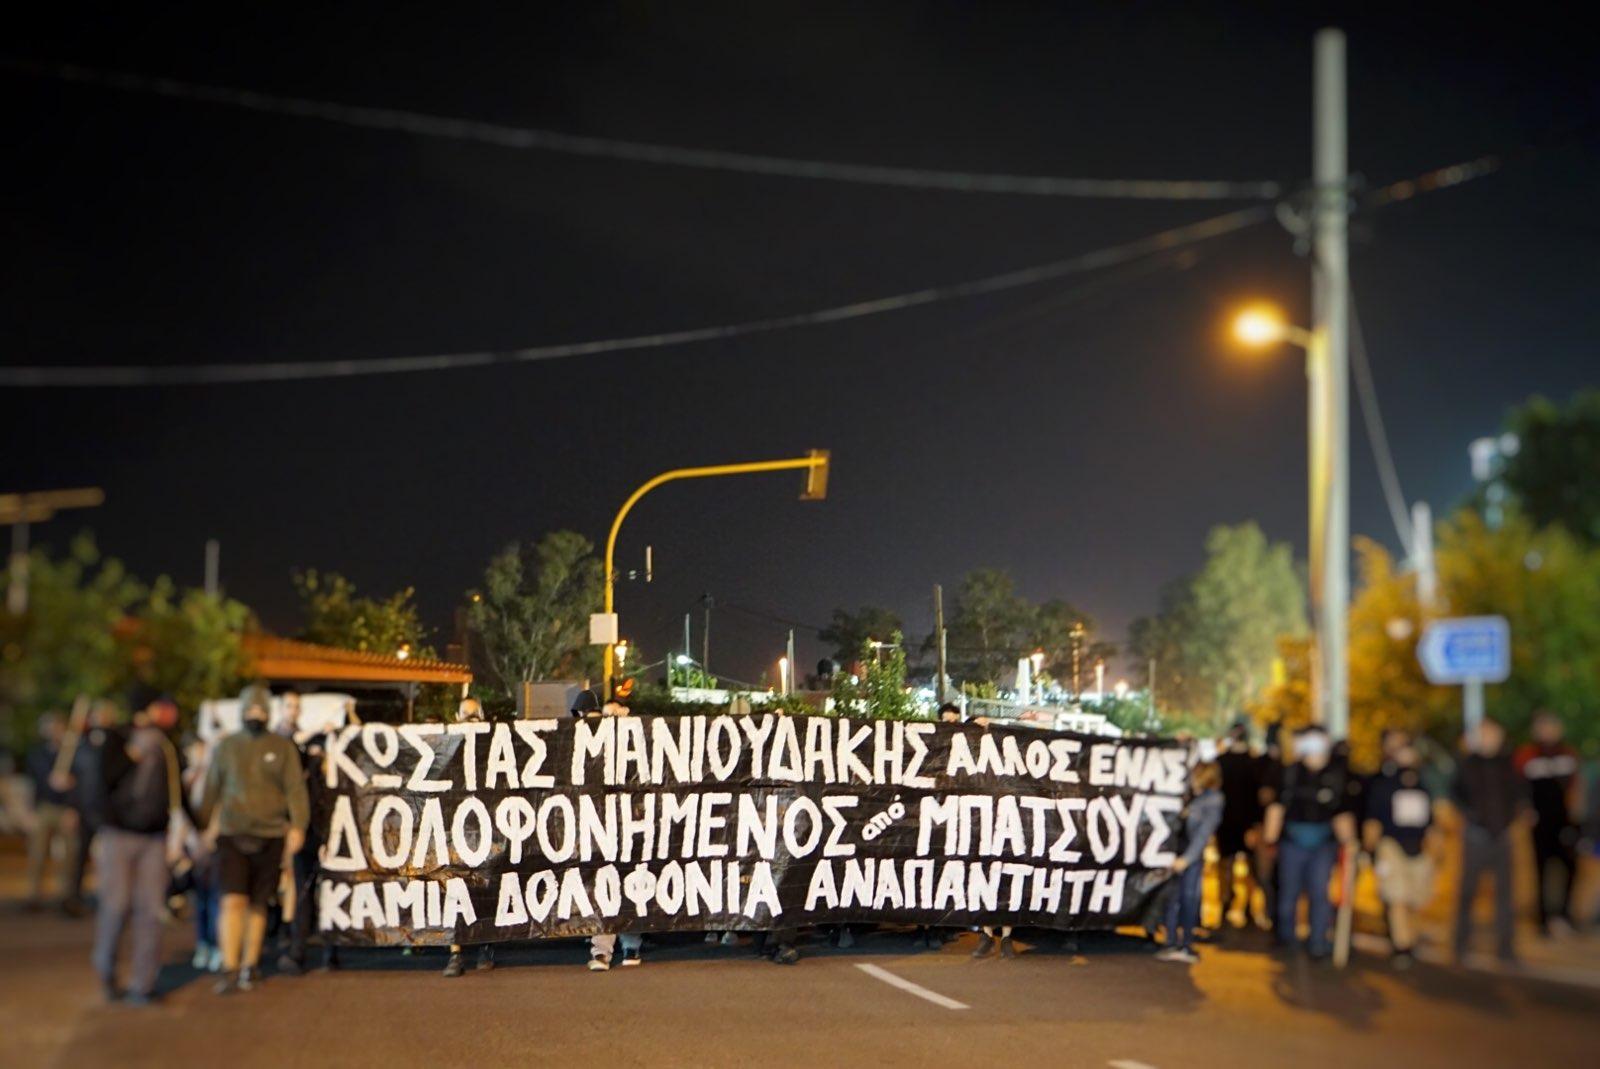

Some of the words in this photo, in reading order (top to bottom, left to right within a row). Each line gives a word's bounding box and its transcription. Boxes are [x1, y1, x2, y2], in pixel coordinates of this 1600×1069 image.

[326, 719, 558, 791] ΚΩΣΤΑΣ
[571, 714, 936, 788] ΜΑΝΙΟΥΔΑΚΗΣ
[946, 732, 1083, 783] ΑΛΛΟΣ
[320, 793, 858, 870] ΔΟΛΟΦΟΝΗΜΕΝΟΣ
[861, 794, 905, 841] από
[916, 794, 1182, 868] ΜΠΑΤΣΟΥΣ
[318, 877, 477, 931] ΚΑΜΙΑ
[494, 859, 783, 927] ΔΟΛΟΦΟΝΙΑ
[803, 857, 1127, 914] ΑΝΑΠΑΝΤΗΤΗ
